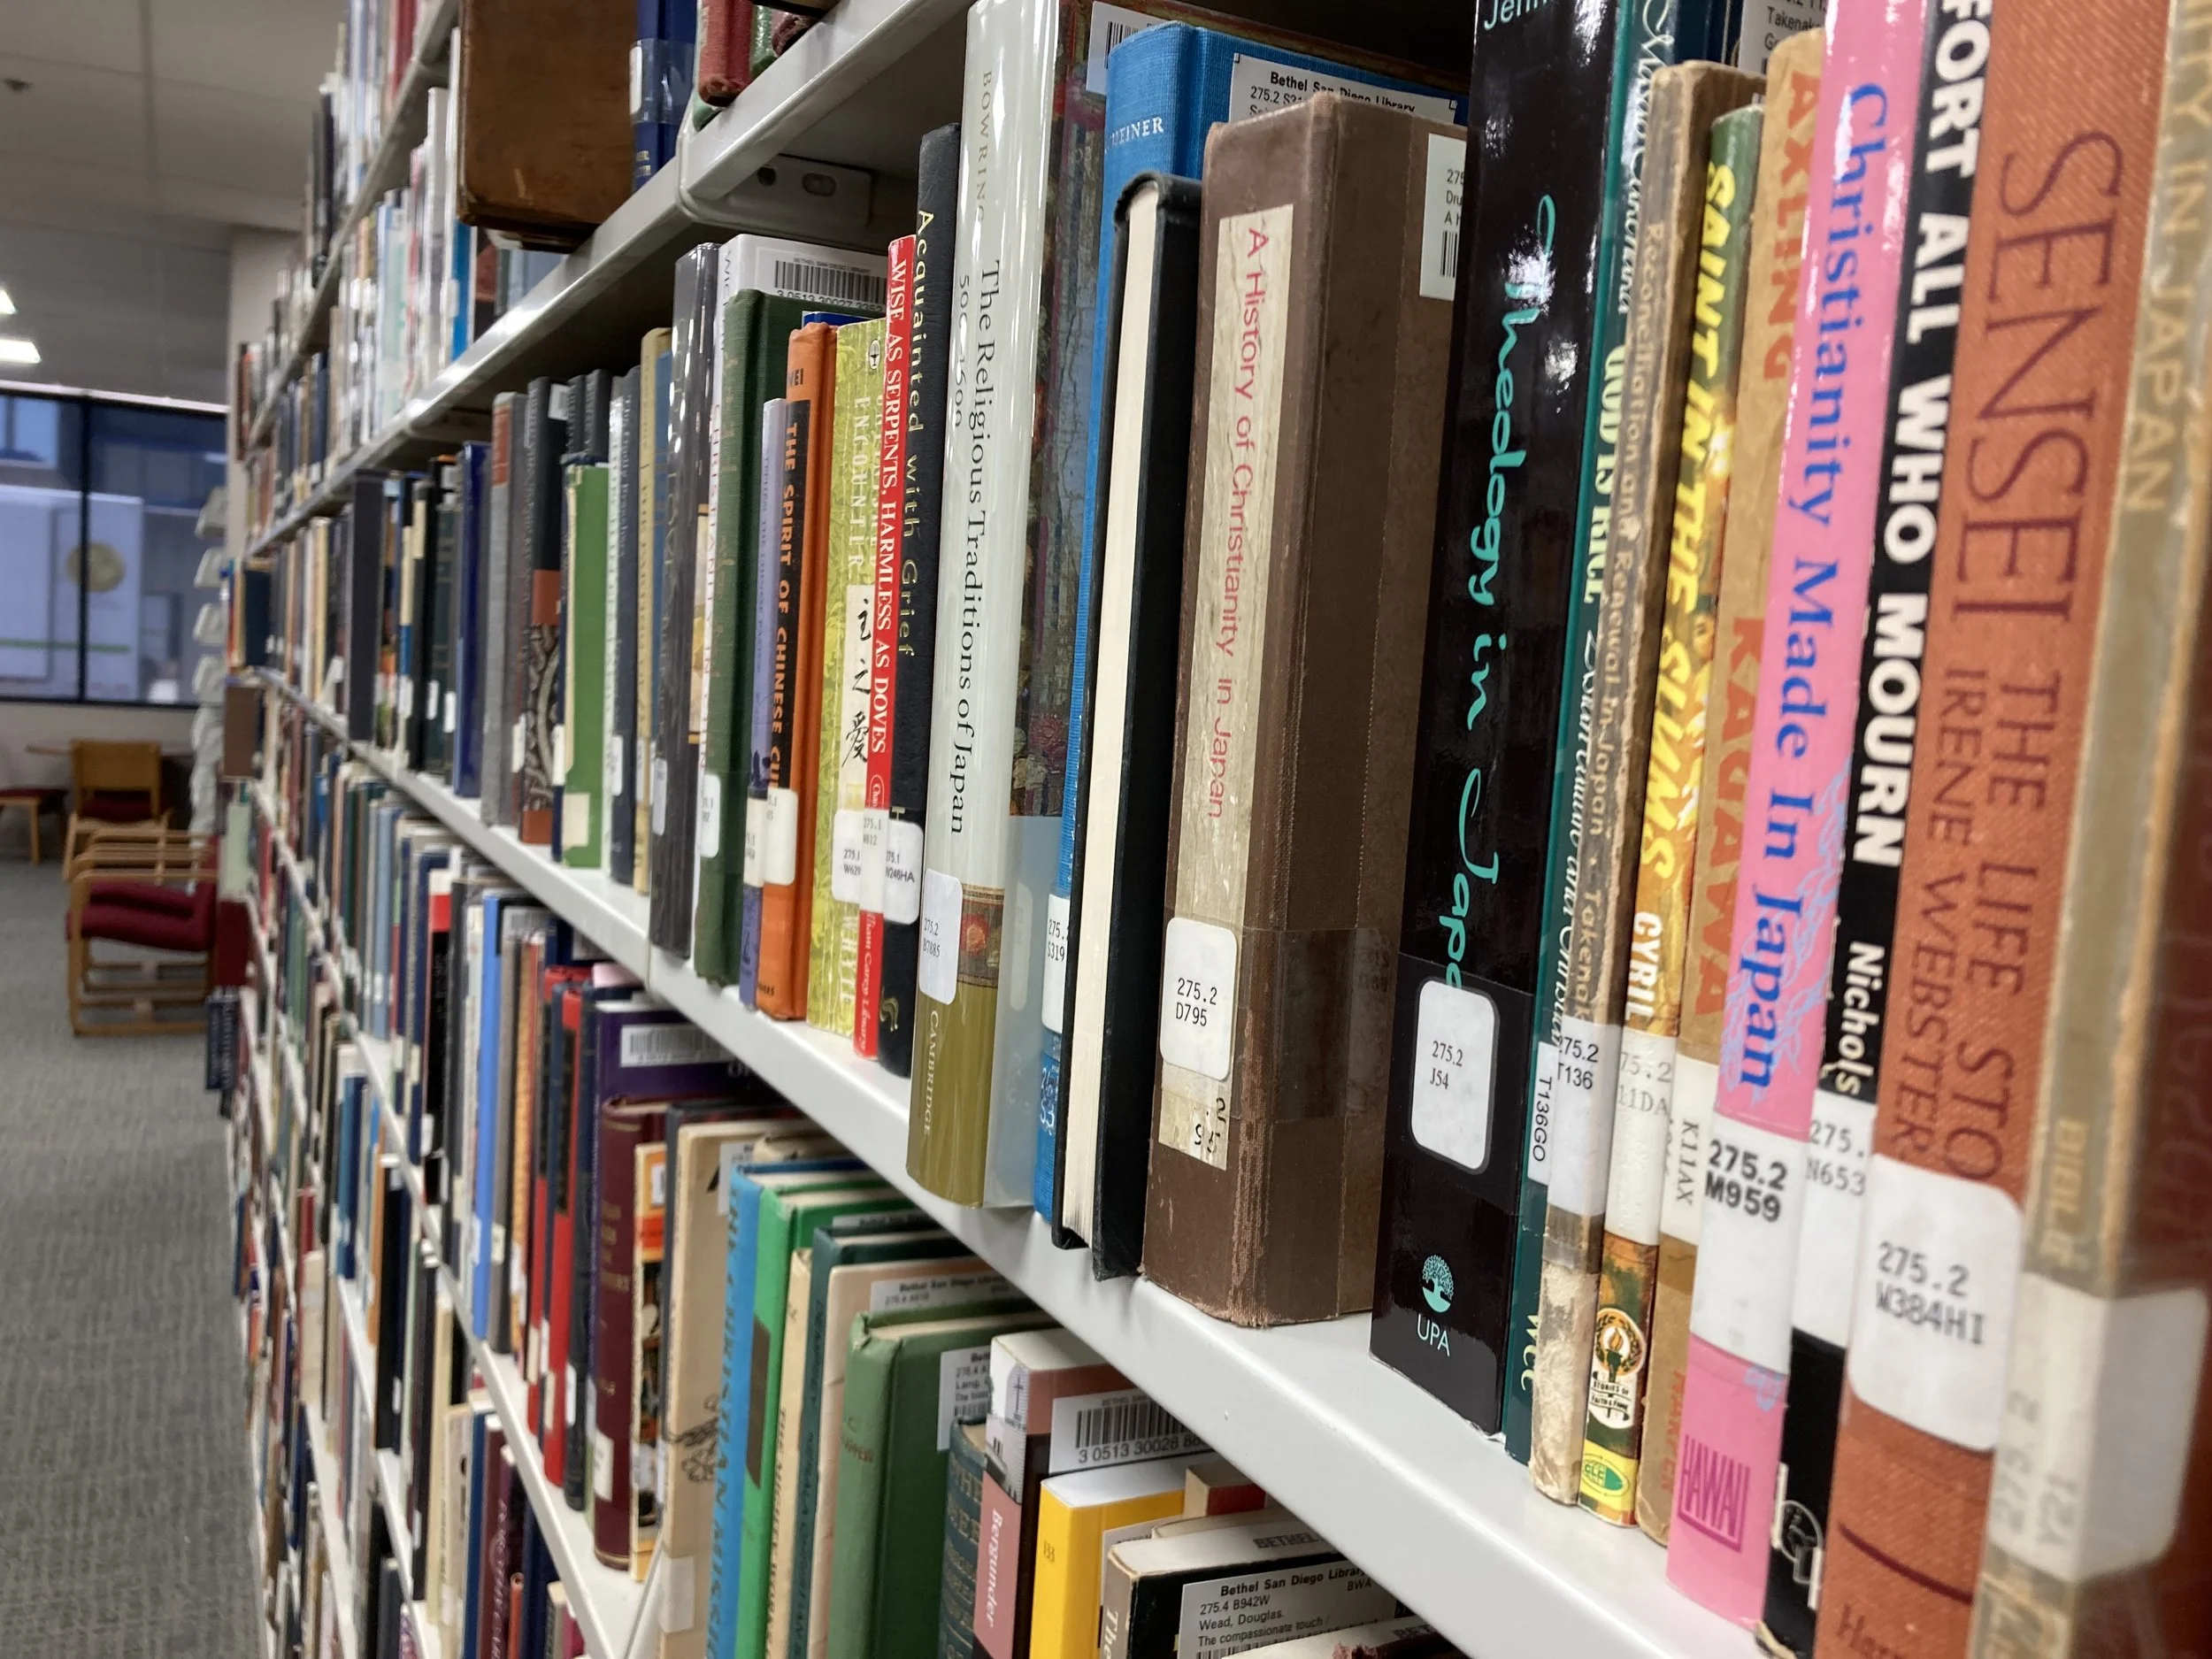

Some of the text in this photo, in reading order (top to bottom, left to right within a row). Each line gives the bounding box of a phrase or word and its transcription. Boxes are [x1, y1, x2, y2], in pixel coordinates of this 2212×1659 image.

[1249, 85, 1280, 104] 275.2
[1270, 71, 1308, 92] Bethel
[1763, 70, 1821, 380] AXLING
[889, 259, 907, 320] WISE
[1693, 162, 1737, 379] SAINT
[1788, 82, 1888, 526] Christianity
[1906, 212, 1970, 345] ALL
[887, 334, 903, 363] AS
[1624, 223, 1665, 466] Reconciliation
[1950, 130, 2123, 622] SENSEI
[880, 368, 902, 495] SERPENTS,
[898, 210, 934, 657] Acquainted with Grief
[1682, 379, 1717, 463] IN
[2125, 274, 2196, 511] JAPAN
[785, 421, 797, 472] THE
[1884, 374, 1953, 564] WHO
[779, 484, 795, 566] SPIRIT
[1208, 227, 1269, 818] A History of Christianity in Japan
[1617, 469, 1642, 541] and
[875, 501, 897, 631] HARMLESS
[949, 259, 1001, 834] The Religious Traditions of Japan
[1667, 482, 1708, 613] THE
[777, 580, 790, 614] OF
[1605, 549, 1634, 684] Renewal
[772, 626, 787, 734] CHINESE
[874, 639, 890, 669] AS
[1467, 633, 1508, 730] in
[1776, 557, 1839, 759] Made
[872, 677, 890, 754] DOVES
[1853, 593, 1930, 867] MOURN
[1588, 733, 1614, 835] Japan
[1694, 617, 1766, 1015] KAGAWA
[1763, 787, 1815, 859] In
[922, 938, 941, 958] B7885
[923, 917, 940, 937] 275.2
[1048, 918, 1068, 941] 275.
[1892, 665, 1990, 1154] IRENE WEBSTER
[1947, 669, 2062, 1181] THE LIFE STO
[1047, 941, 1065, 962] S319
[1177, 977, 1218, 1007] 275.2
[1571, 890, 1602, 1019] Takenak
[1624, 910, 1663, 1021] CYRIL
[1739, 883, 1803, 1089] Japan
[1175, 1002, 1208, 1028] D795
[1432, 1040, 1464, 1068] 275.2
[1834, 941, 1886, 1097] Nichols
[924, 1009, 940, 1136] CAMBRIDGE
[1430, 1066, 1449, 1090] J54
[1619, 1051, 1672, 1084] 75.2
[1532, 1075, 1553, 1163] T136GO
[1809, 1119, 1865, 1158] 275.
[1703, 1170, 1781, 1223] M959
[1709, 1139, 1787, 1191] 275.2
[1805, 1156, 1867, 1198] N653
[1878, 1240, 1970, 1299] 275.2
[1416, 1313, 1451, 1357] UPA
[1875, 1280, 1986, 1348] W384HI
[1079, 1449, 1087, 1464] 3
[1092, 1443, 1130, 1462] 0513
[985, 1508, 1004, 1629] Bergunder
[1200, 1594, 1271, 1616] 275.4 B942W
[1221, 1581, 1259, 1597] Bethel
[1264, 1578, 1286, 1591] San
[1291, 1572, 1325, 1586] Diego
[1347, 1578, 1371, 1592] BWA
[1198, 1617, 1324, 1647] The compassionate touch
